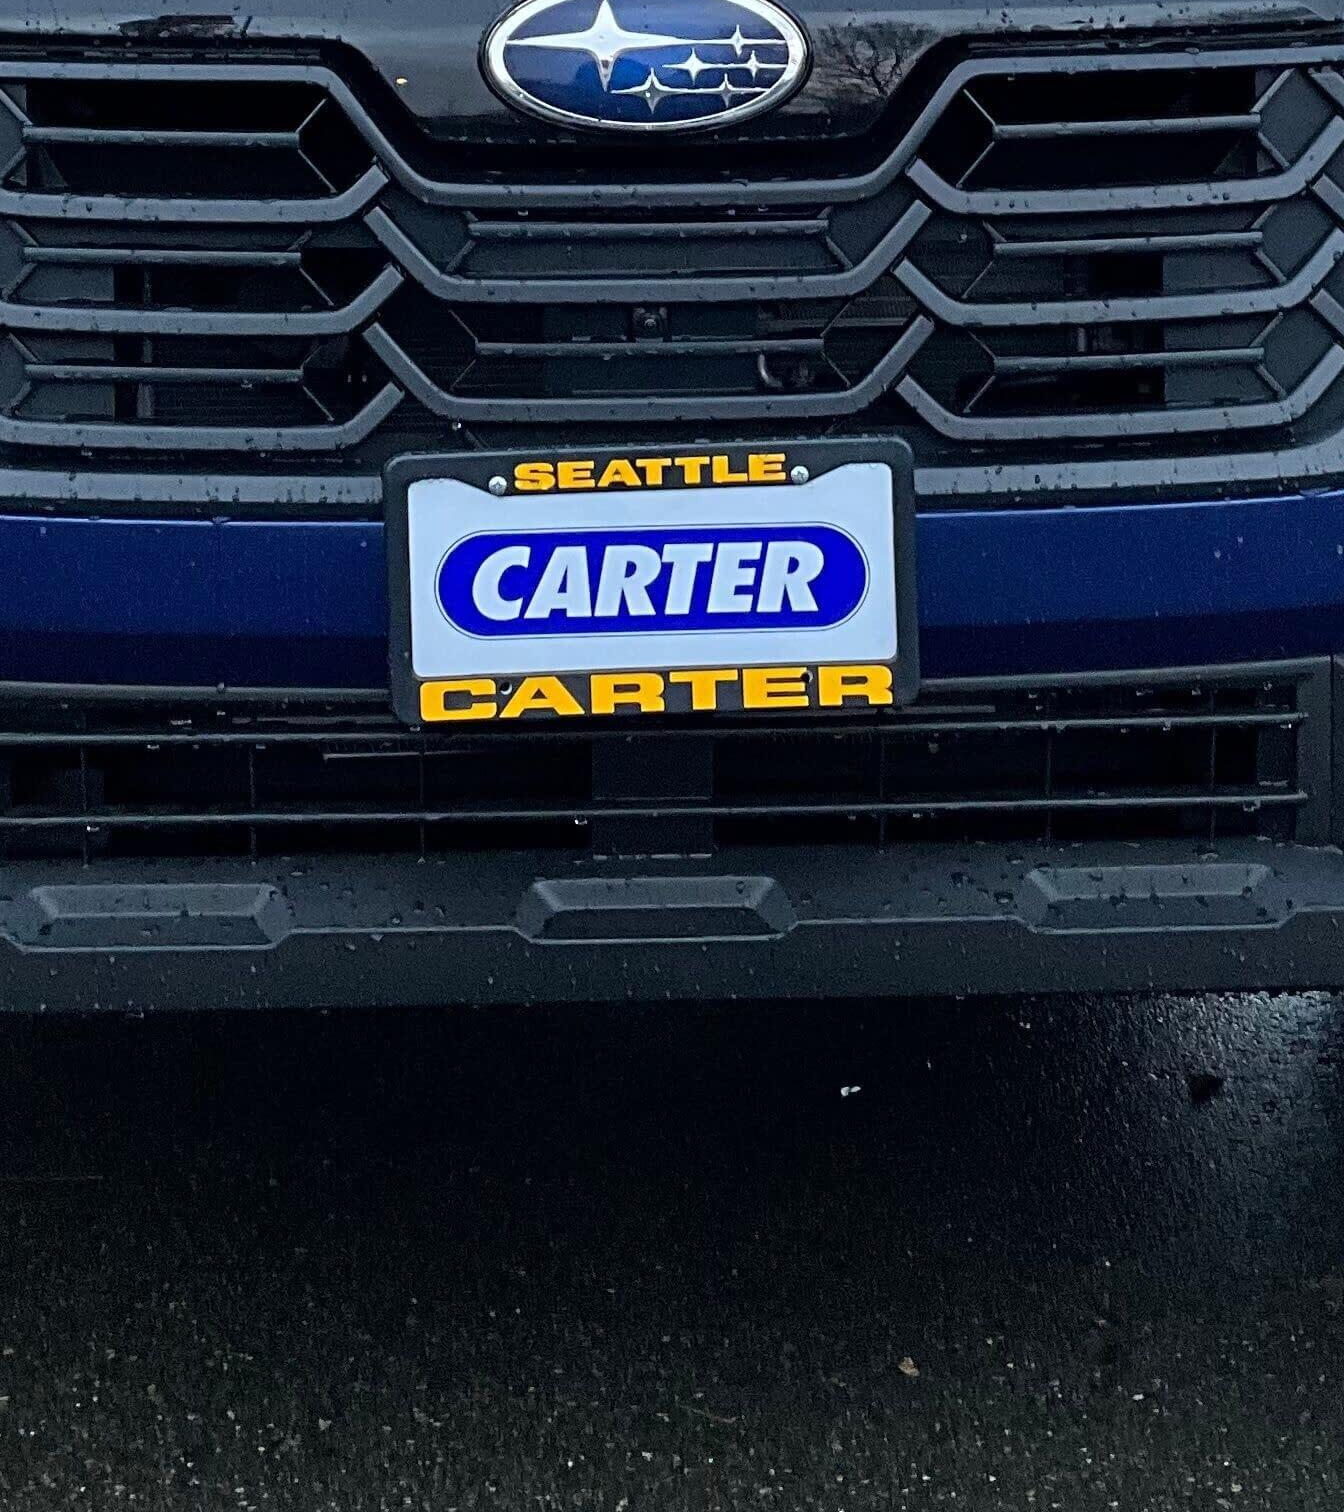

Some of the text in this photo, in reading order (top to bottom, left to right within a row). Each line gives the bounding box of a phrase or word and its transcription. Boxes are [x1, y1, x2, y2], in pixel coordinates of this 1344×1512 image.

[513, 453, 786, 492] SEATTLE
[471, 541, 825, 621] CARTER
[419, 664, 894, 723] CARTER
